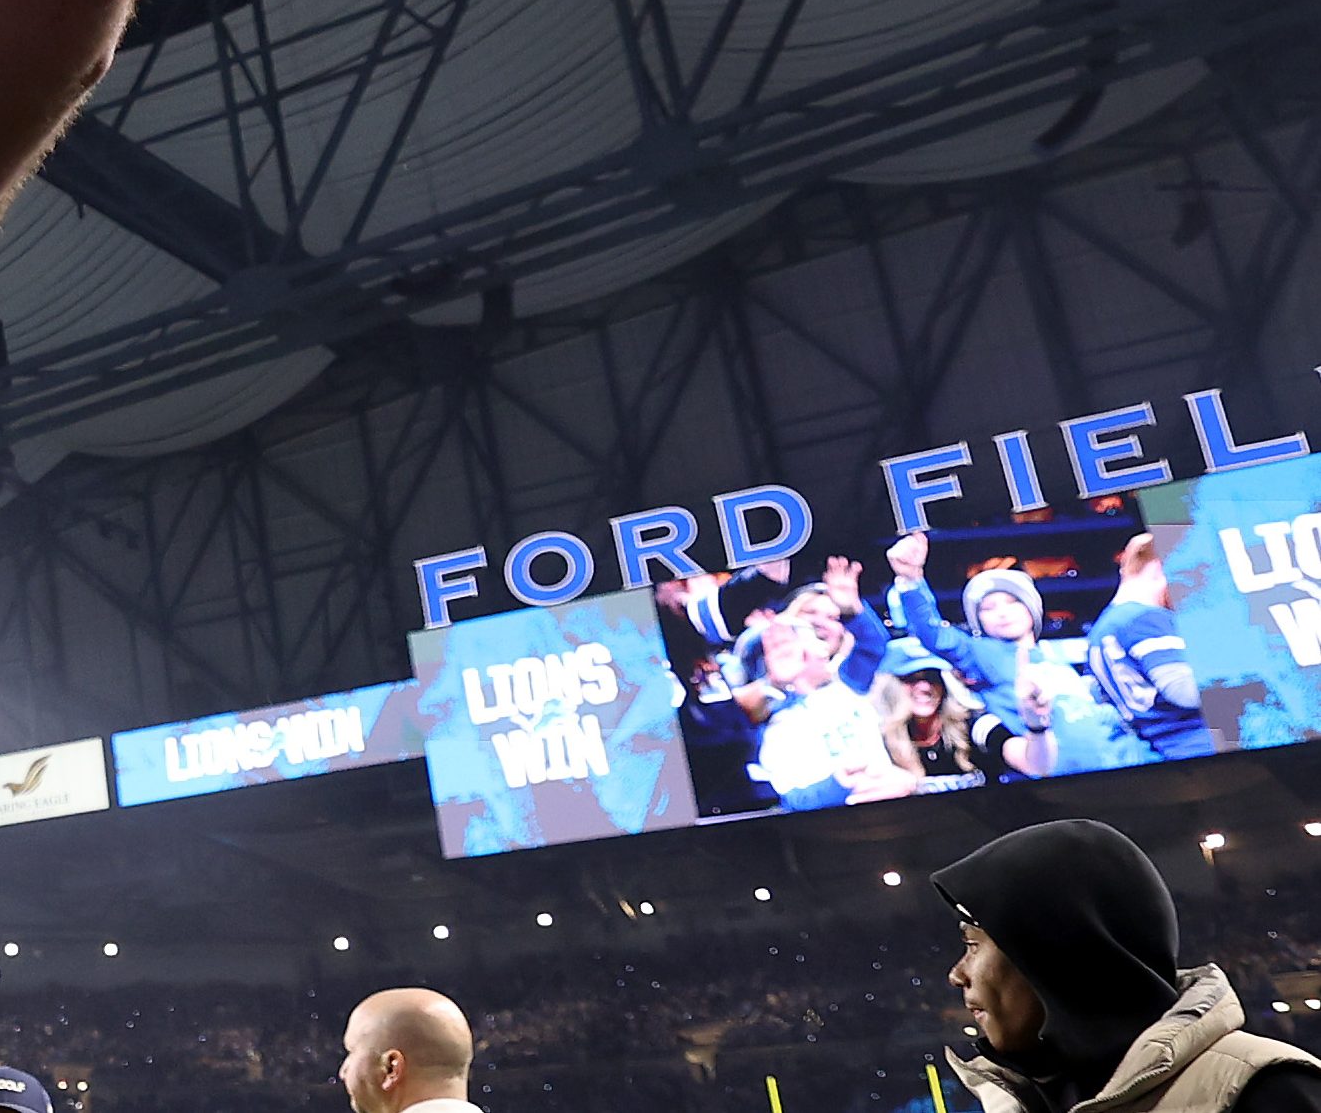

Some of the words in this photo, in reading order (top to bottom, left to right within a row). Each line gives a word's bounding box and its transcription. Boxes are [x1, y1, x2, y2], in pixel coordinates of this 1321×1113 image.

[413, 484, 813, 629] FORD
[879, 366, 1321, 536] FIEL
[462, 642, 618, 725] LIONS
[165, 720, 280, 782] LIONS
[277, 706, 365, 765] WIN
[491, 714, 610, 788] WIN
